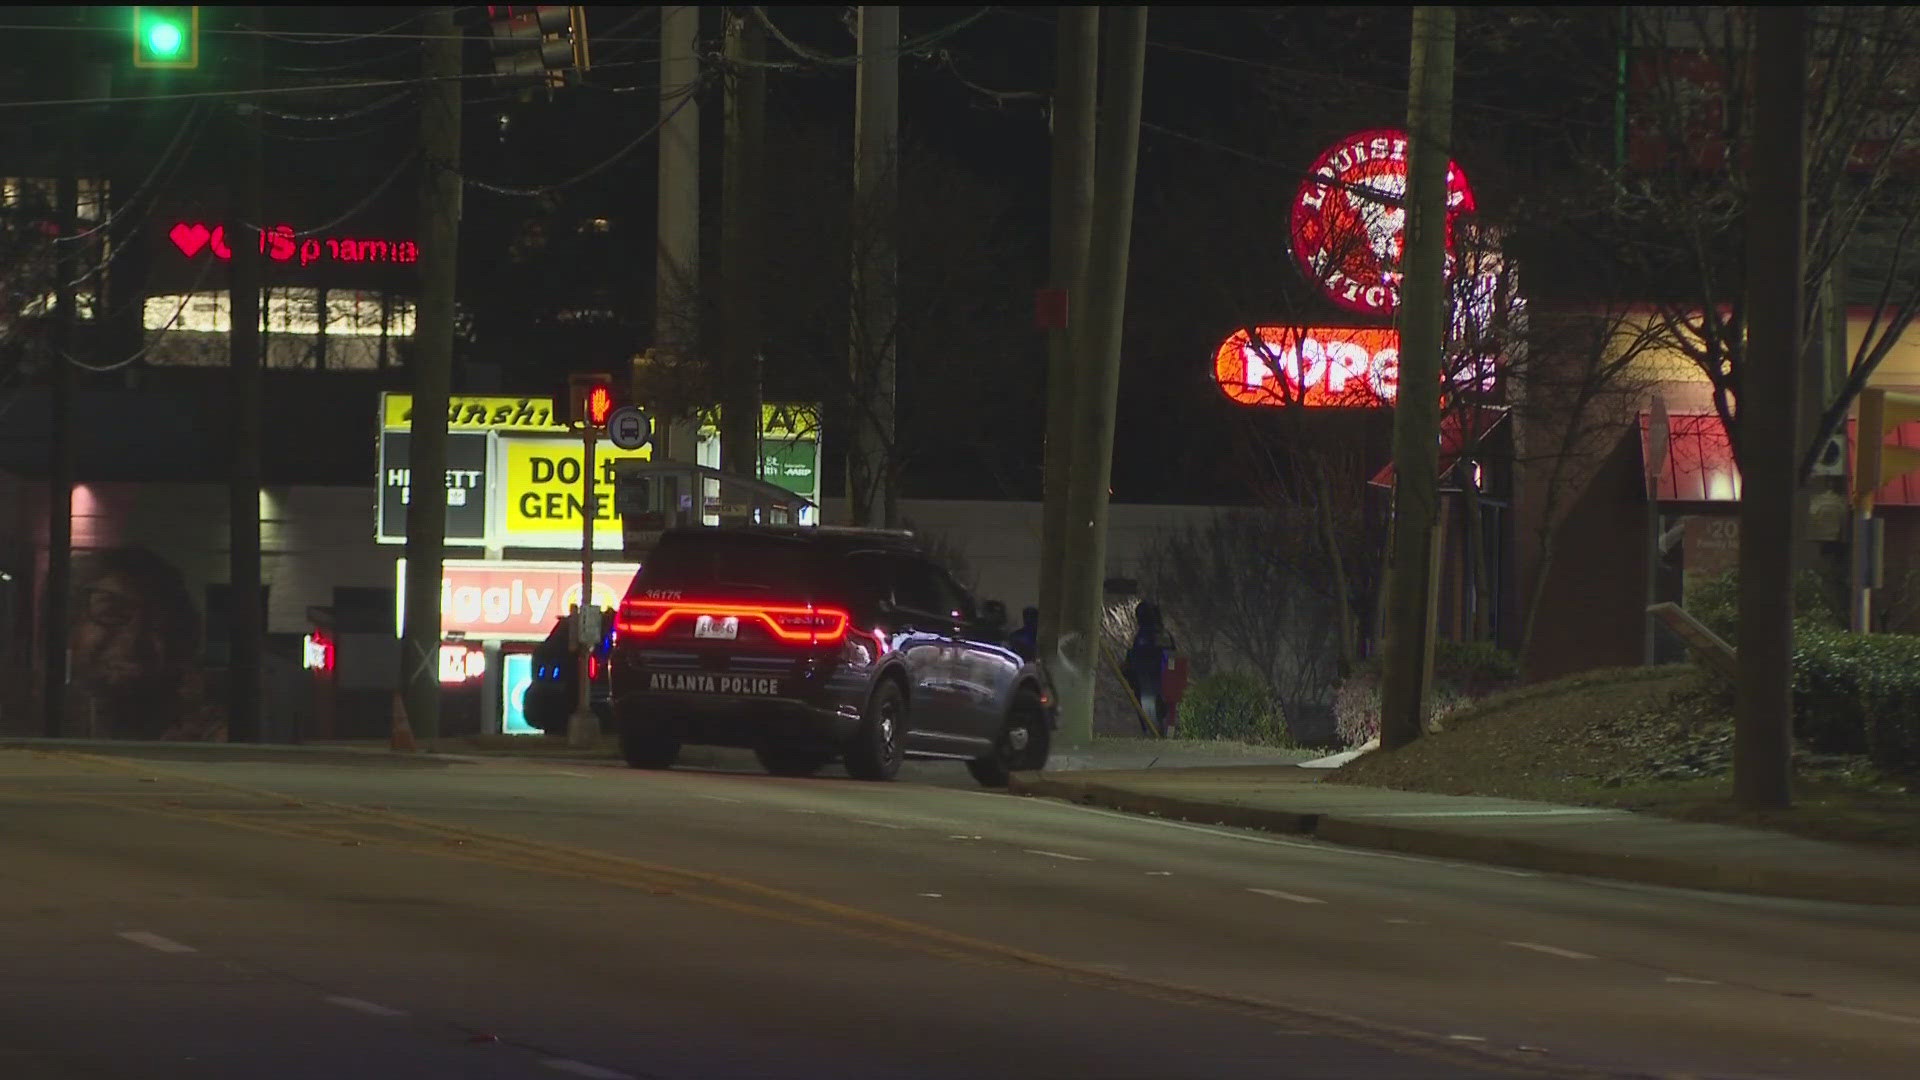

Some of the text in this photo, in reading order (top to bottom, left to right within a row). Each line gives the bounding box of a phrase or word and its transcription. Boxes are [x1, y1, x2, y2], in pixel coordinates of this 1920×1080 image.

[1302, 137, 1465, 211] LOUISI
[210, 224, 297, 261] CS
[1242, 336, 1497, 400] POPE
[388, 468, 484, 488] HIETT
[519, 491, 620, 519] GENE
[442, 576, 554, 624] iggly
[650, 674, 778, 695] ATLANTA POLICE
